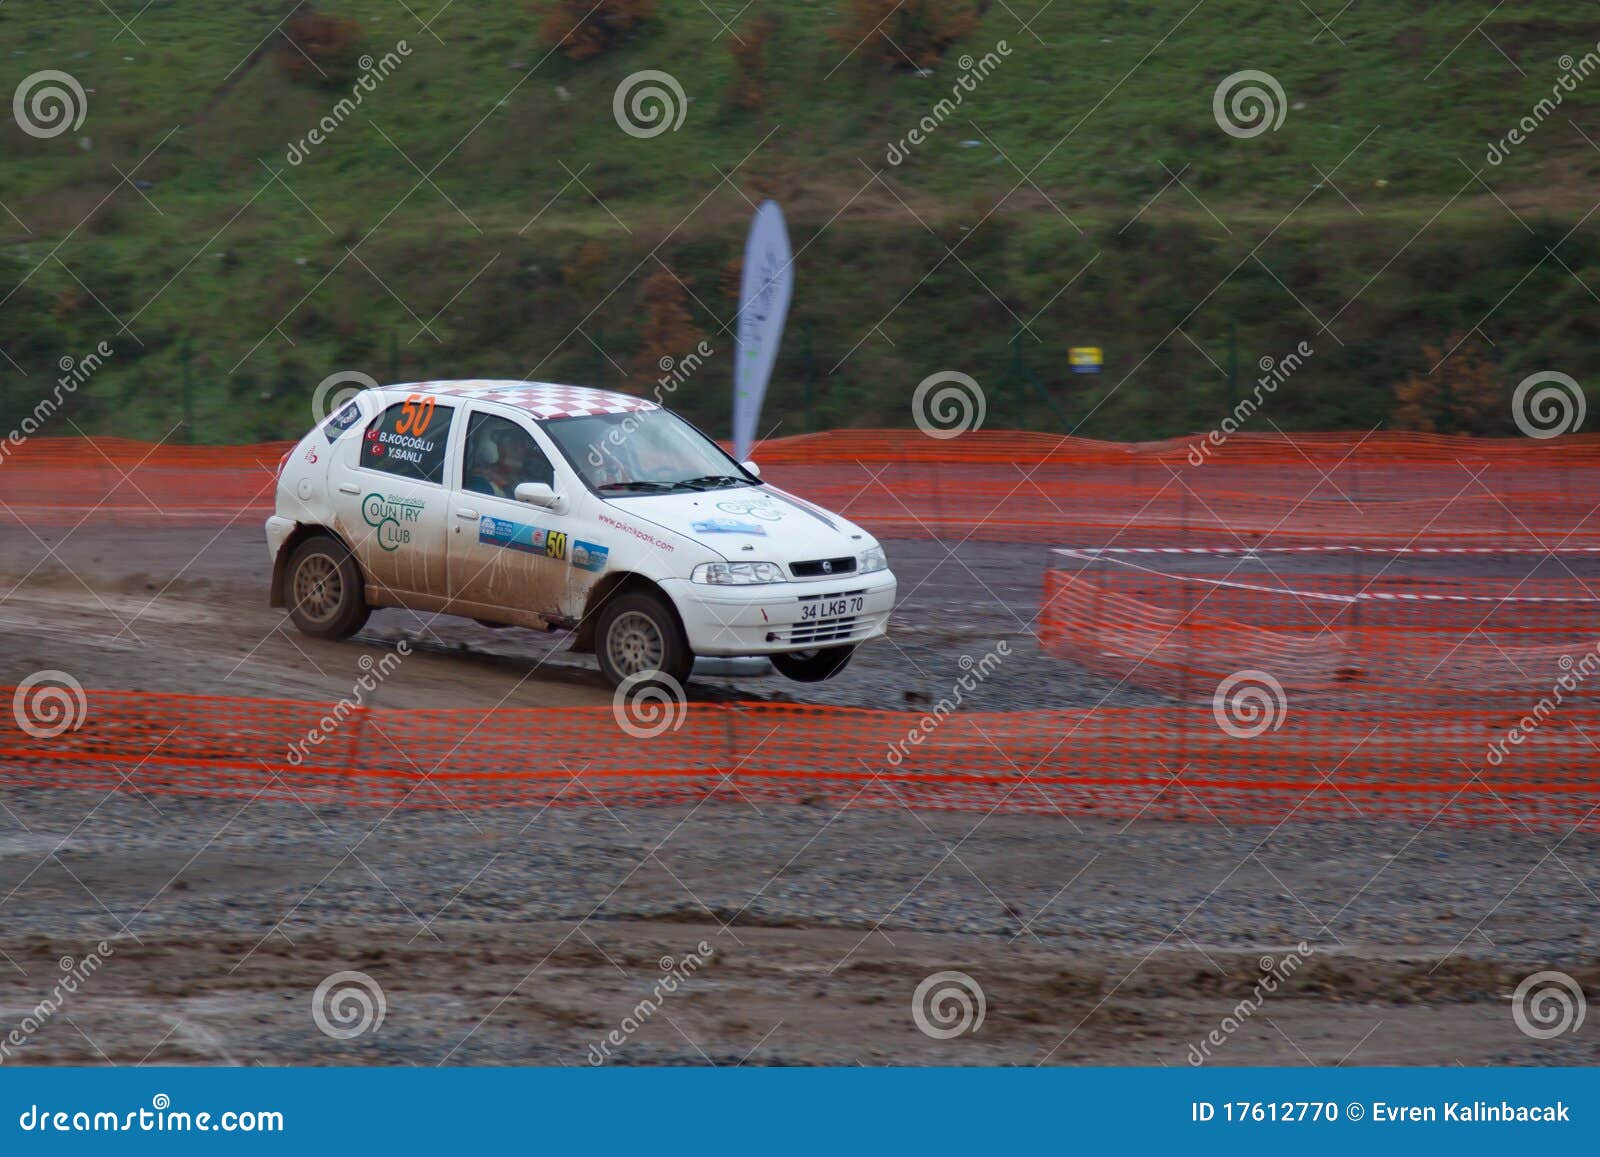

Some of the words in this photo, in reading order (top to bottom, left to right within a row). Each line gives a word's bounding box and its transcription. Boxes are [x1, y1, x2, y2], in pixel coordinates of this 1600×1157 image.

[396, 394, 435, 437] 50
[362, 493, 424, 527] COUNTRY
[377, 517, 410, 551] CLUB
[547, 530, 566, 560] 50
[801, 606, 817, 620] 34
[820, 600, 847, 618] LKB
[850, 597, 863, 612] 70
